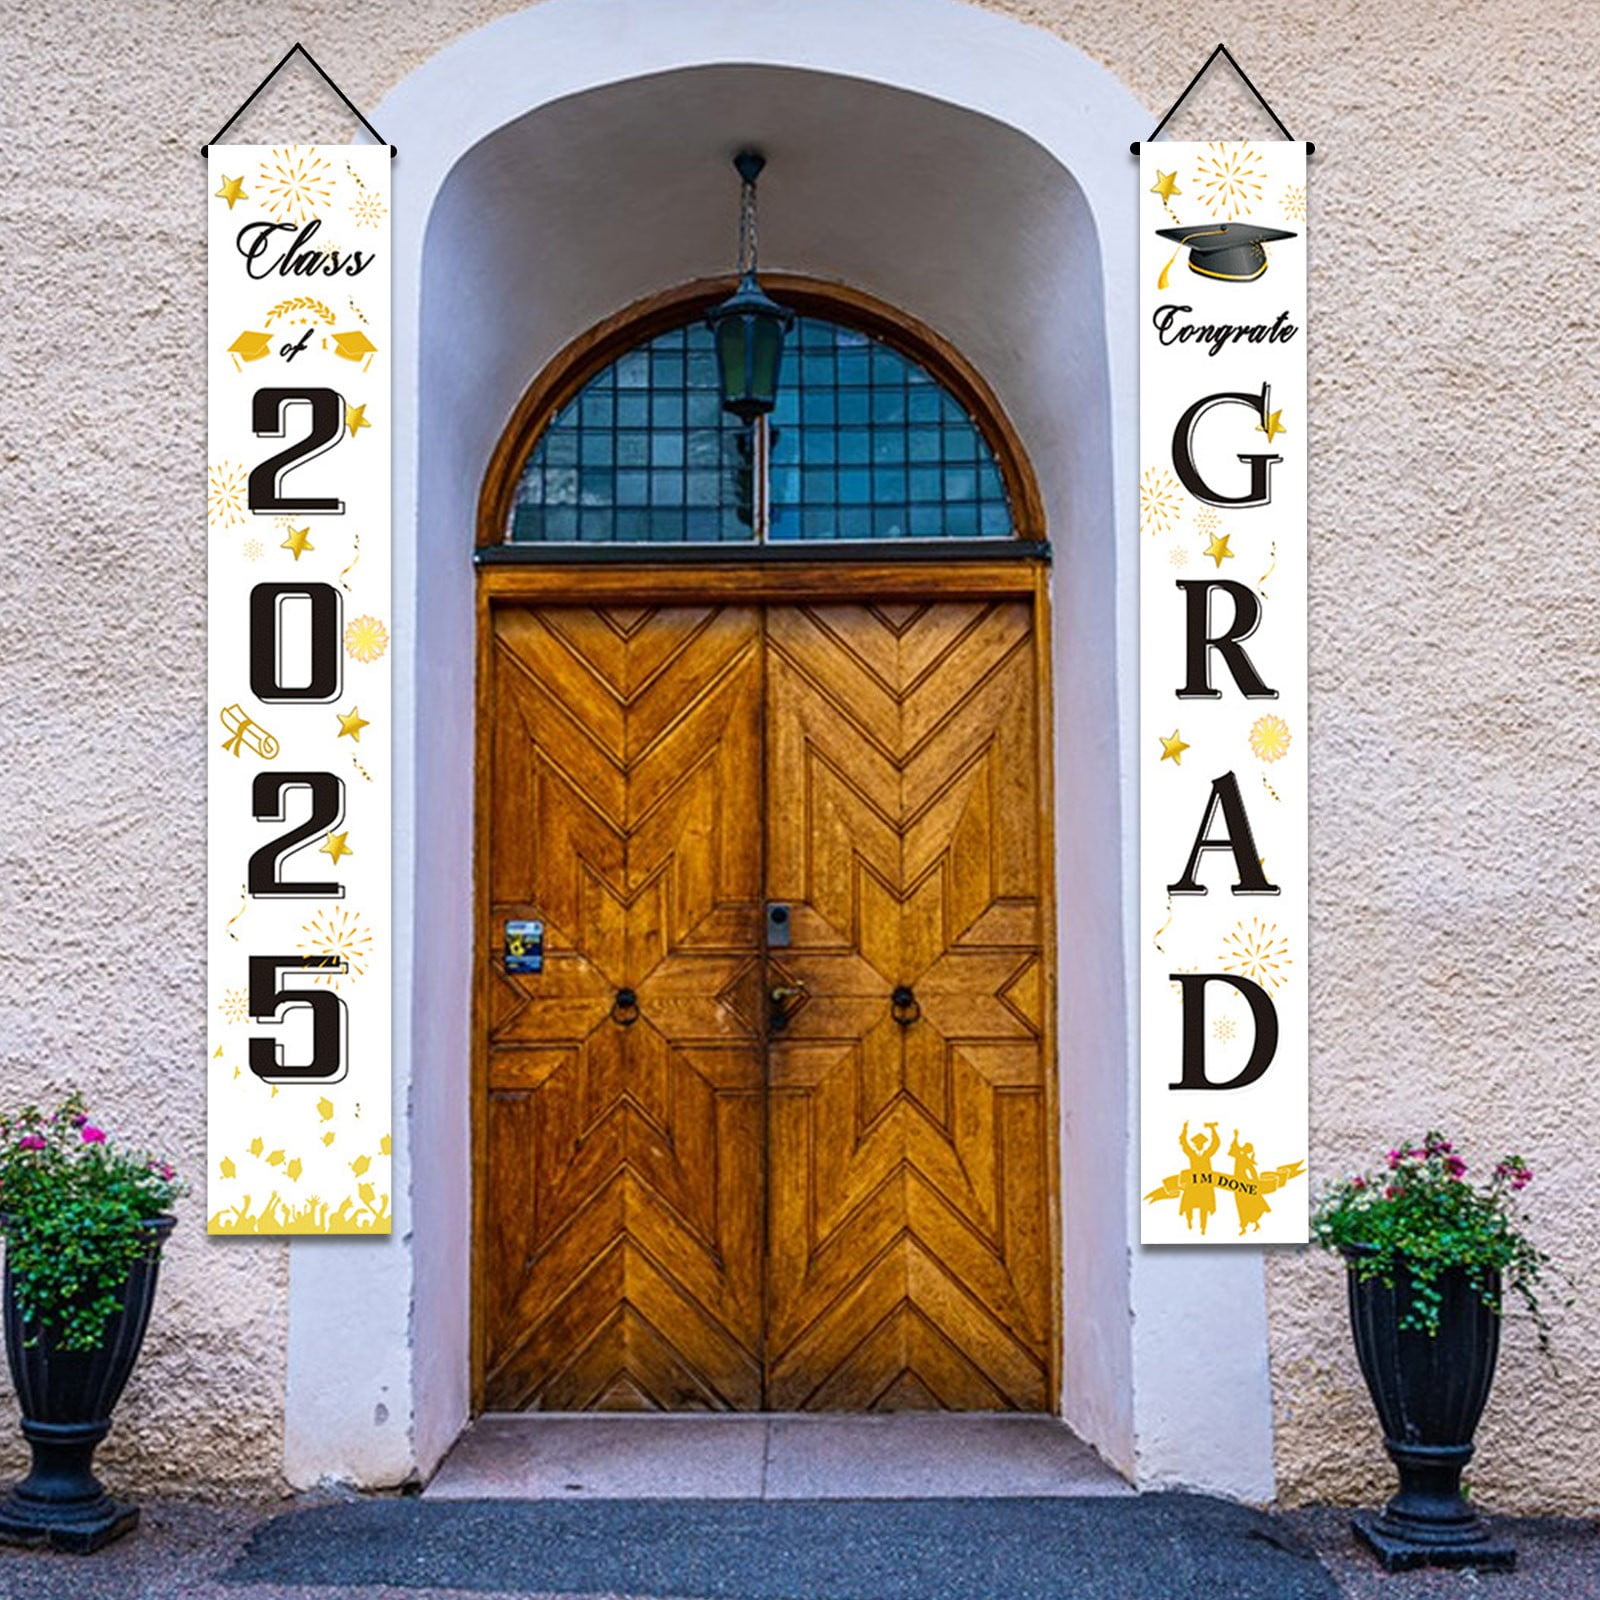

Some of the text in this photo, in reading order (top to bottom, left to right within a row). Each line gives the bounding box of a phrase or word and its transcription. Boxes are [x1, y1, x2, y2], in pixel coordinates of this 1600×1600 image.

[236, 220, 376, 280] Class
[280, 328, 314, 362] of
[1153, 304, 1299, 357] Congrate
[248, 387, 349, 1084] 2025
[1167, 382, 1284, 1090] GRAD
[1217, 1176, 1257, 1195] DONE
